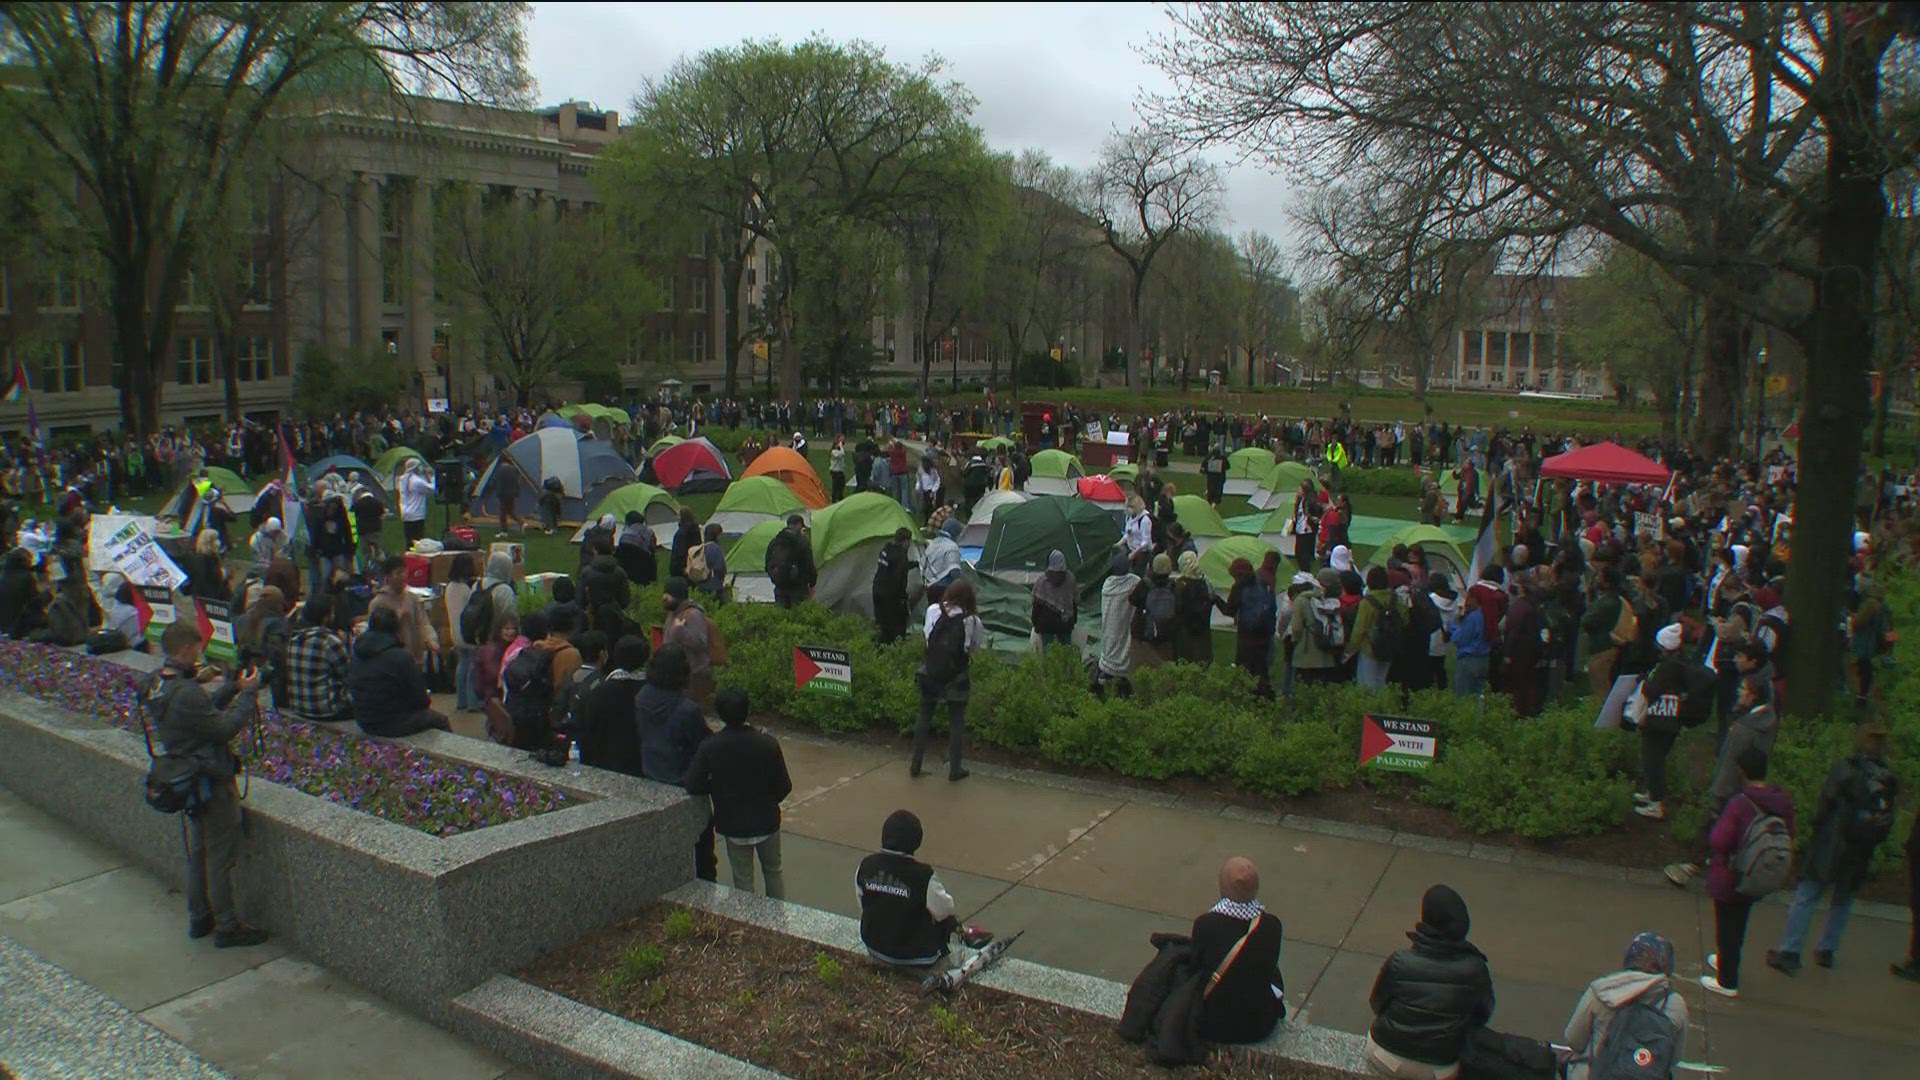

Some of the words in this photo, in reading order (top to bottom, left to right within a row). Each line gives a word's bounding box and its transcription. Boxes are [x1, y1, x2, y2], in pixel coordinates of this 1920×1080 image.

[809, 650, 822, 659] WE
[823, 652, 845, 662] STAND
[824, 667, 843, 676] WITH
[809, 680, 849, 693] PALESTINE
[1383, 720, 1398, 730] WE
[1399, 721, 1430, 732] STAND
[1398, 740, 1423, 750] WITH
